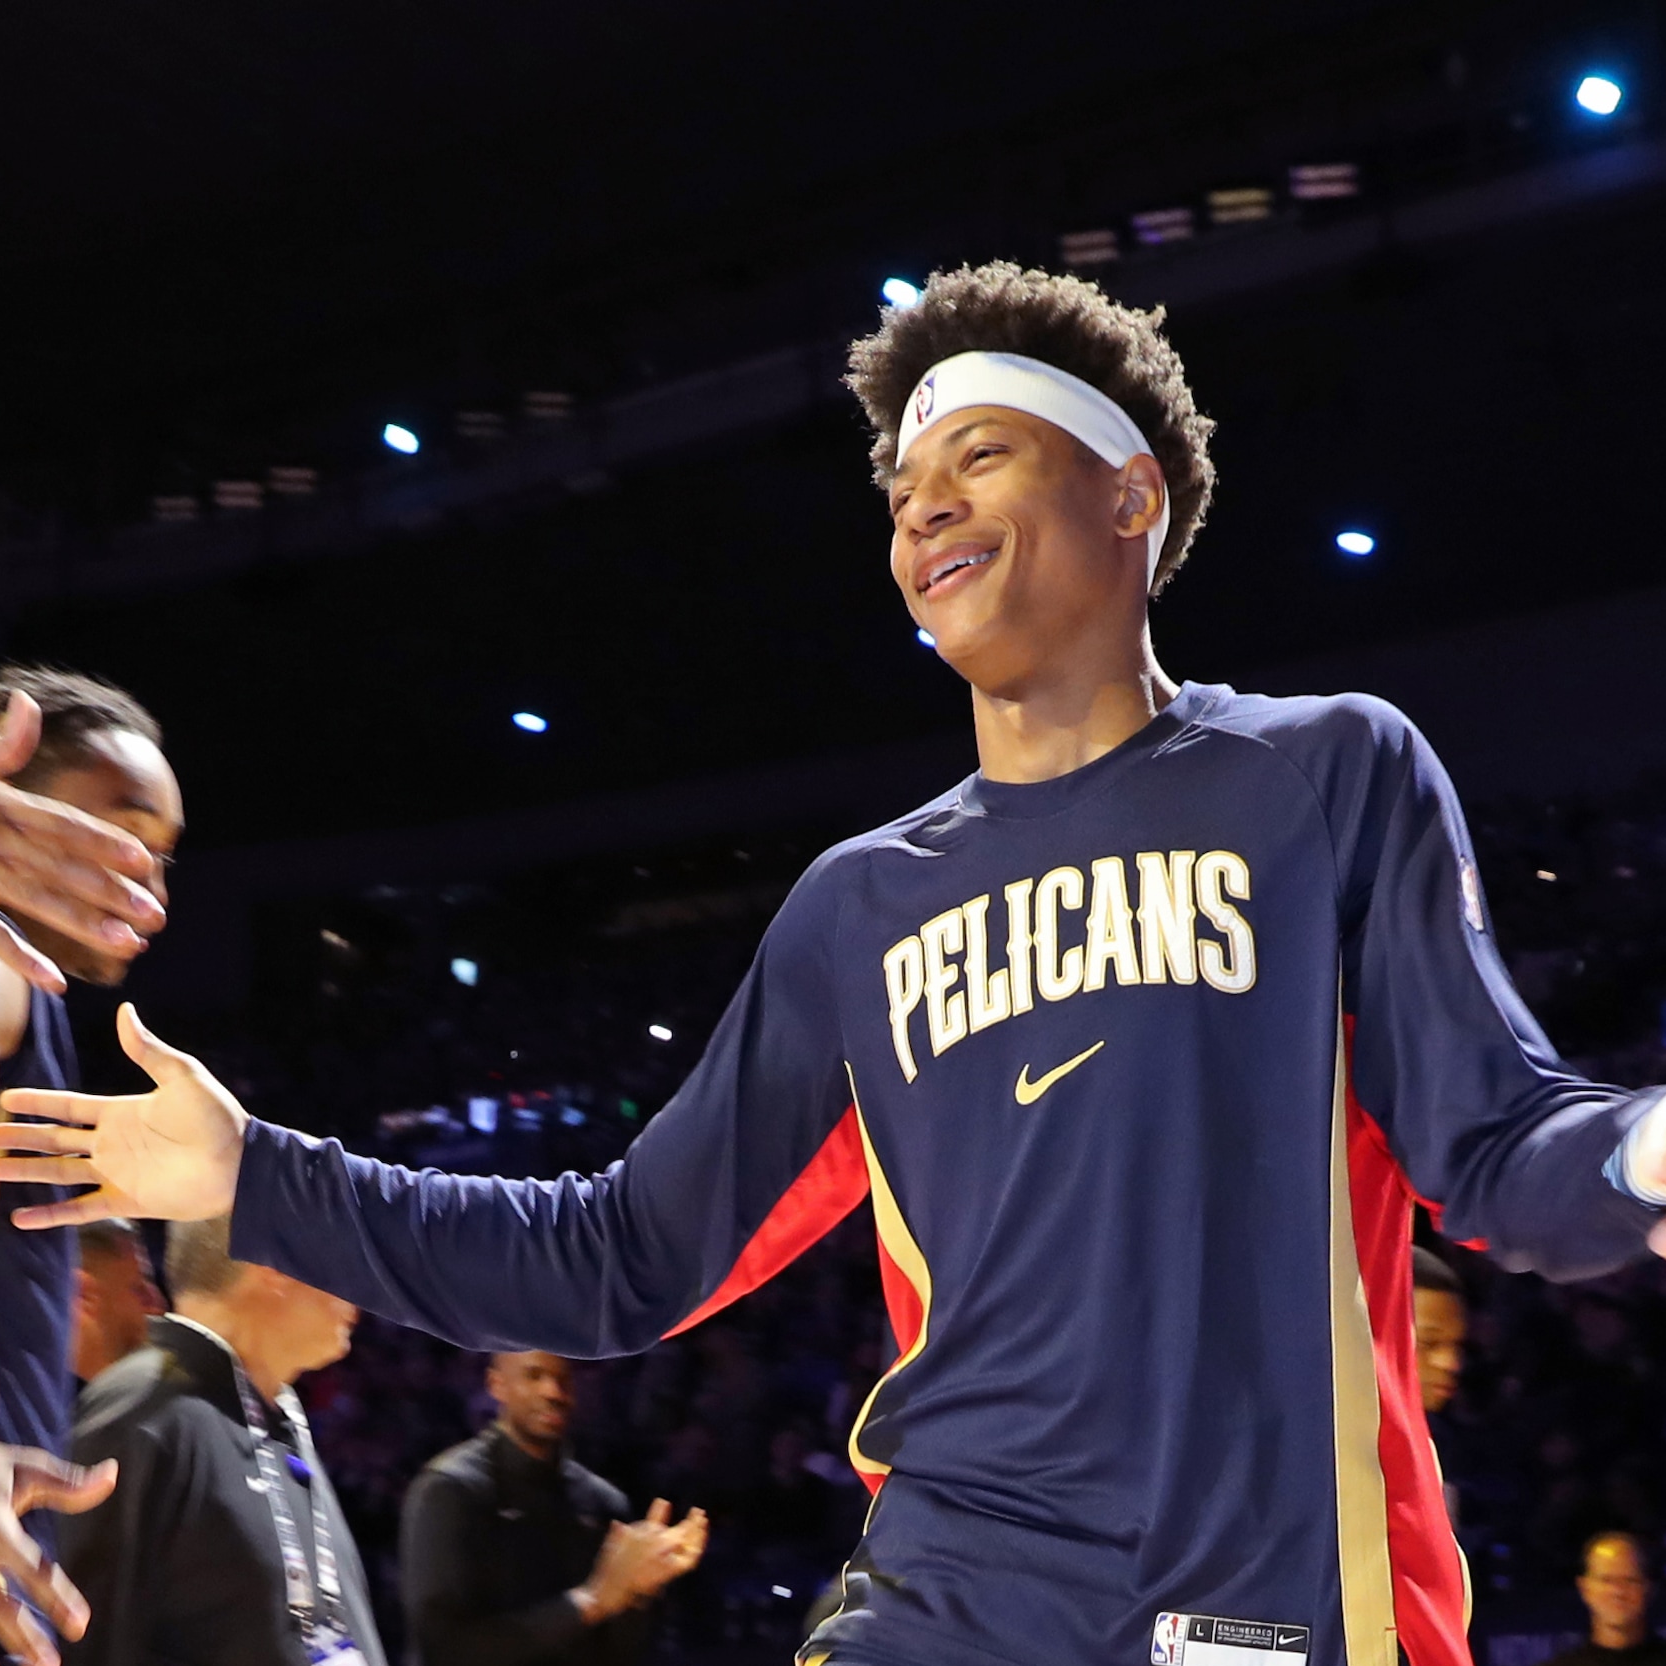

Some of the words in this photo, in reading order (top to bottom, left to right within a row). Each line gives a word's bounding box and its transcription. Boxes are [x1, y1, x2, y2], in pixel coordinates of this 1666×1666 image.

[883, 850, 1257, 1084] PELICANS
[1195, 1623, 1205, 1637] L
[1217, 1624, 1273, 1637] ENGINEERED
